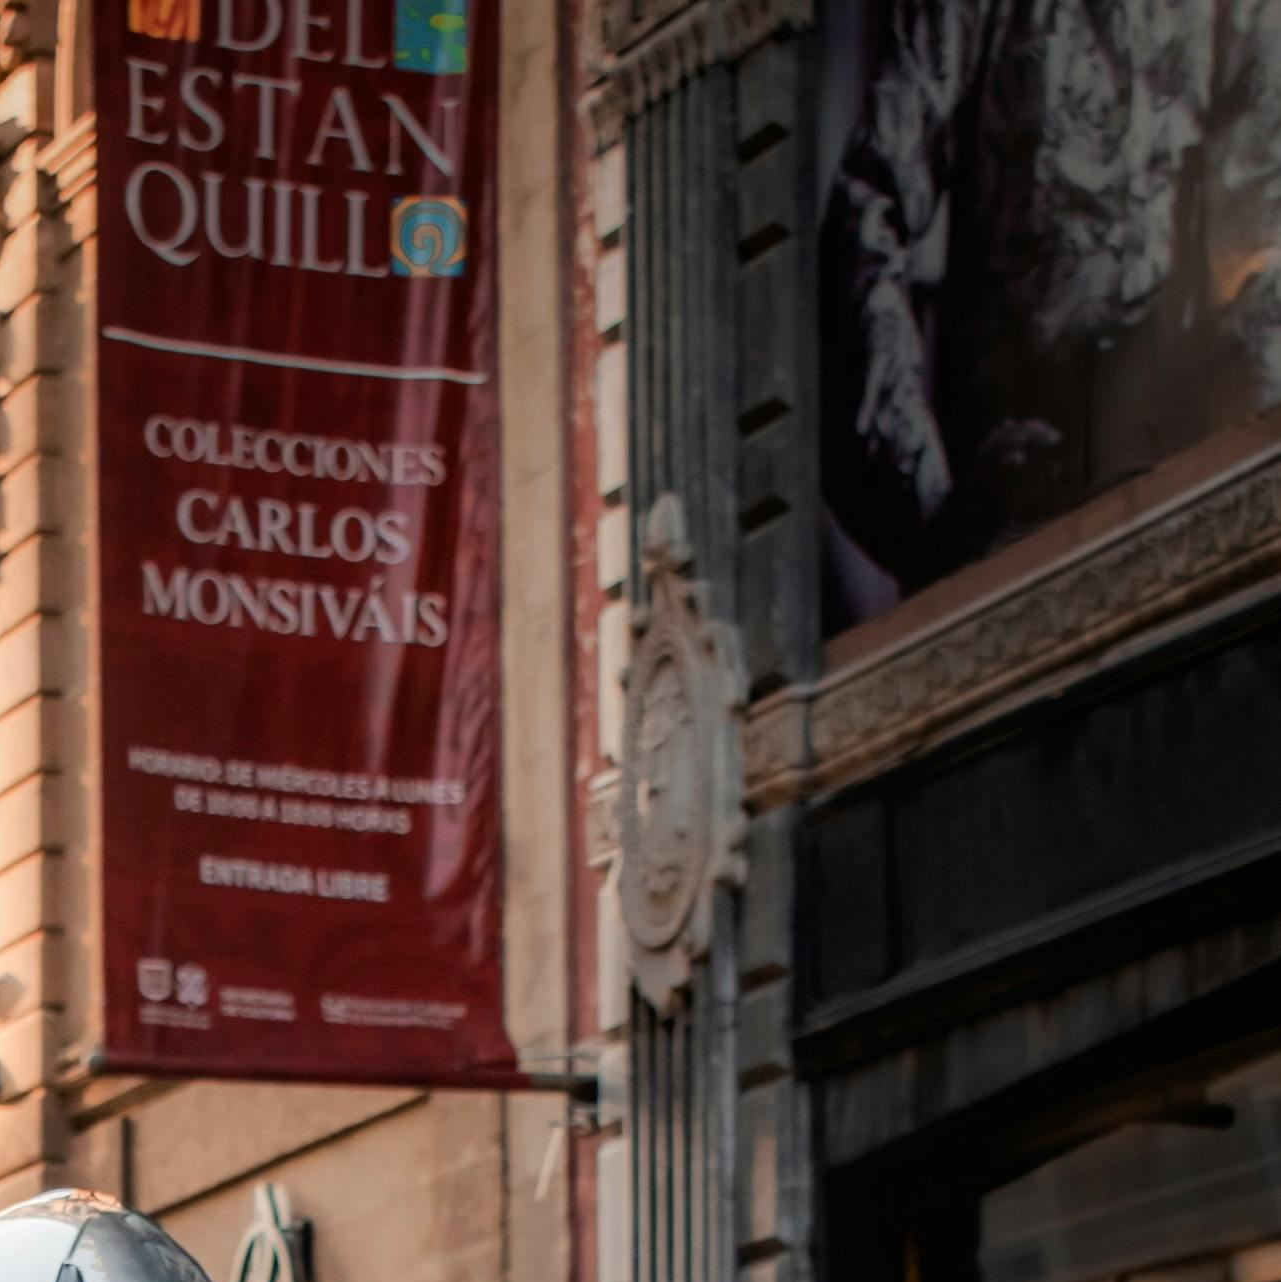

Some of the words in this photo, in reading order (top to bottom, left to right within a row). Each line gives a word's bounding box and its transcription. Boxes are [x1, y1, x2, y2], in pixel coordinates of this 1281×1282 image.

[215, 0, 389, 70] DEL
[124, 57, 461, 178] ESTAN
[144, 415, 448, 487] COLECCIONES
[175, 488, 412, 565] CARLOS
[140, 561, 449, 648] MONSIVÁIS
[199, 854, 315, 897] ENTRADA
[317, 869, 390, 903] LIBRE
